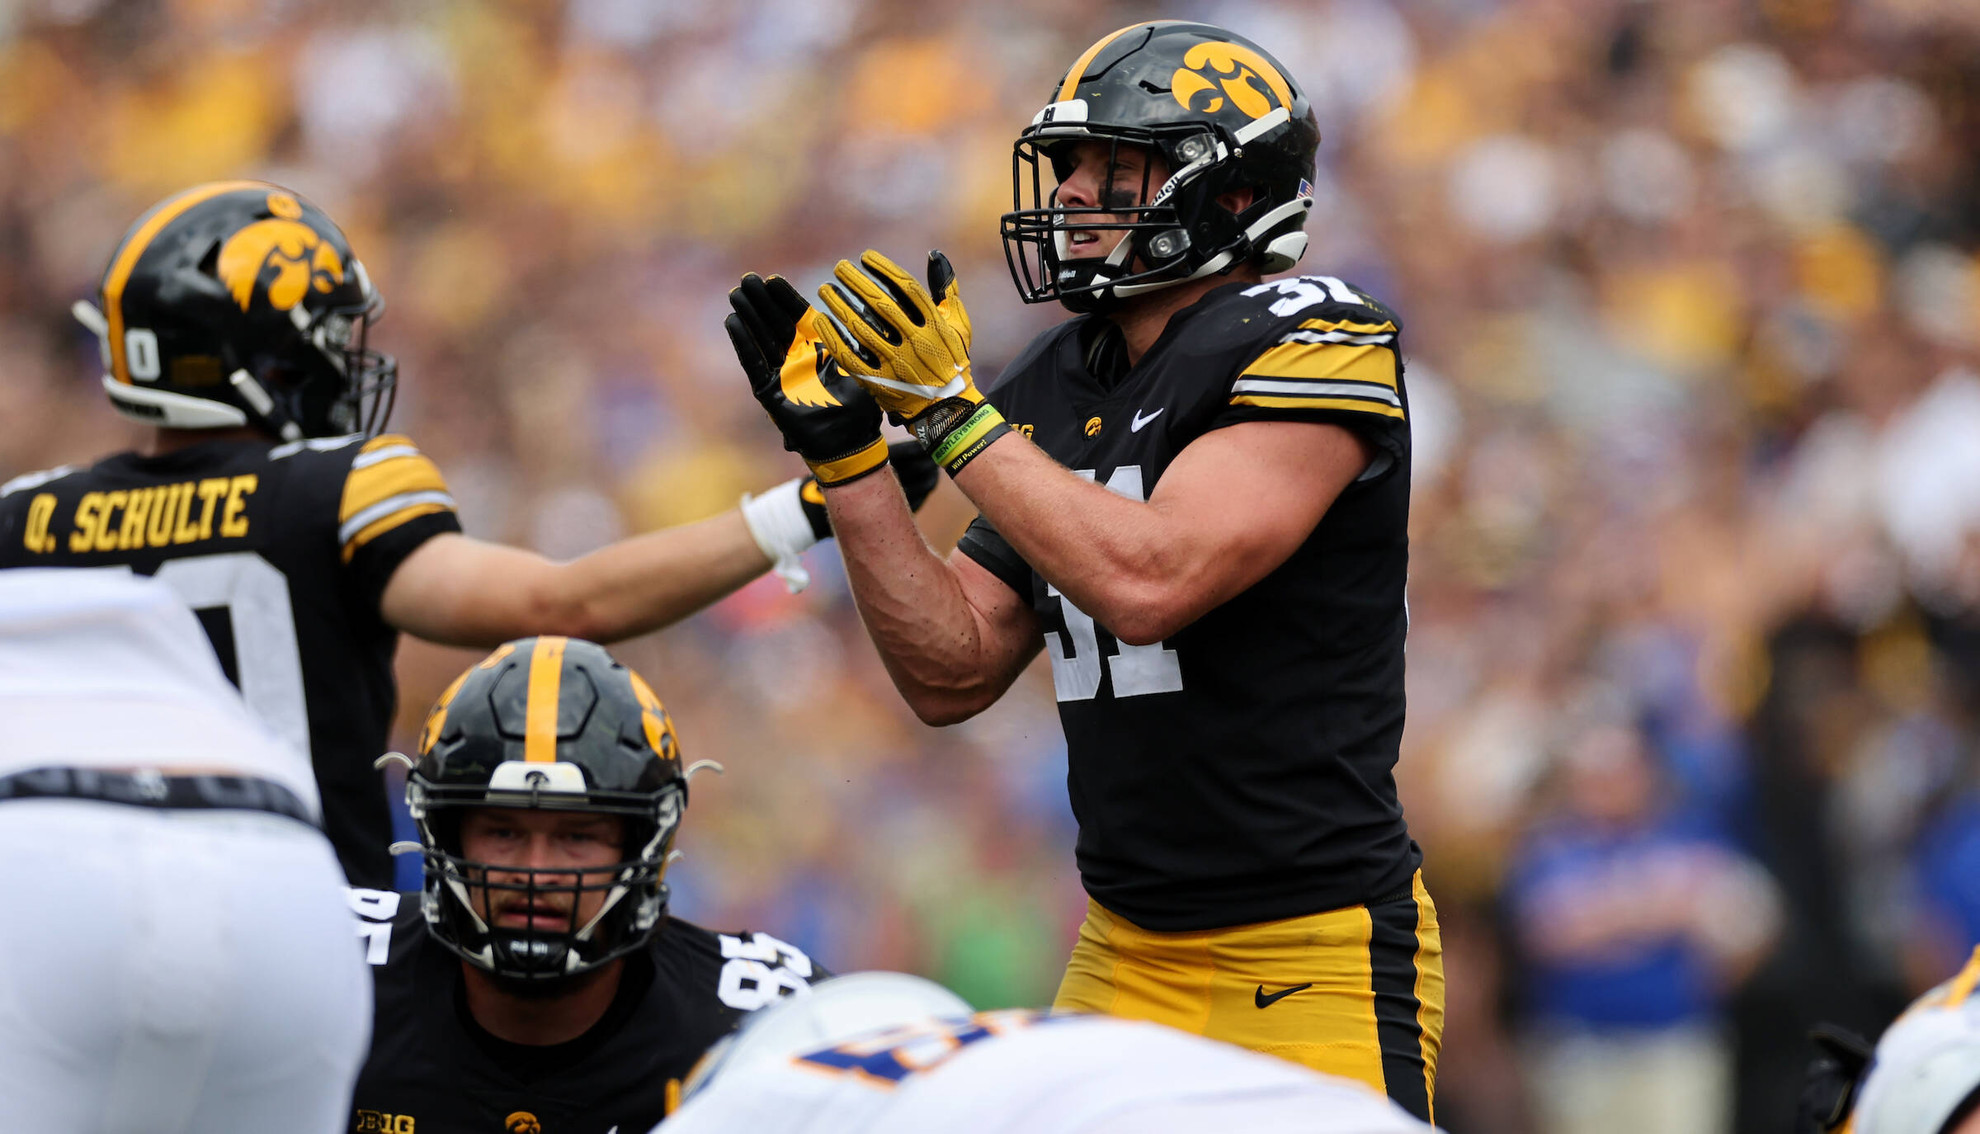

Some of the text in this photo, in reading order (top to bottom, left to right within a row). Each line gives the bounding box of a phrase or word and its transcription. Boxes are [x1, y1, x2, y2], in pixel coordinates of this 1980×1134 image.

[1240, 275, 1364, 317] 31
[125, 327, 161, 382] 0
[951, 458, 964, 470] Will
[69, 473, 259, 553] SCHULTE
